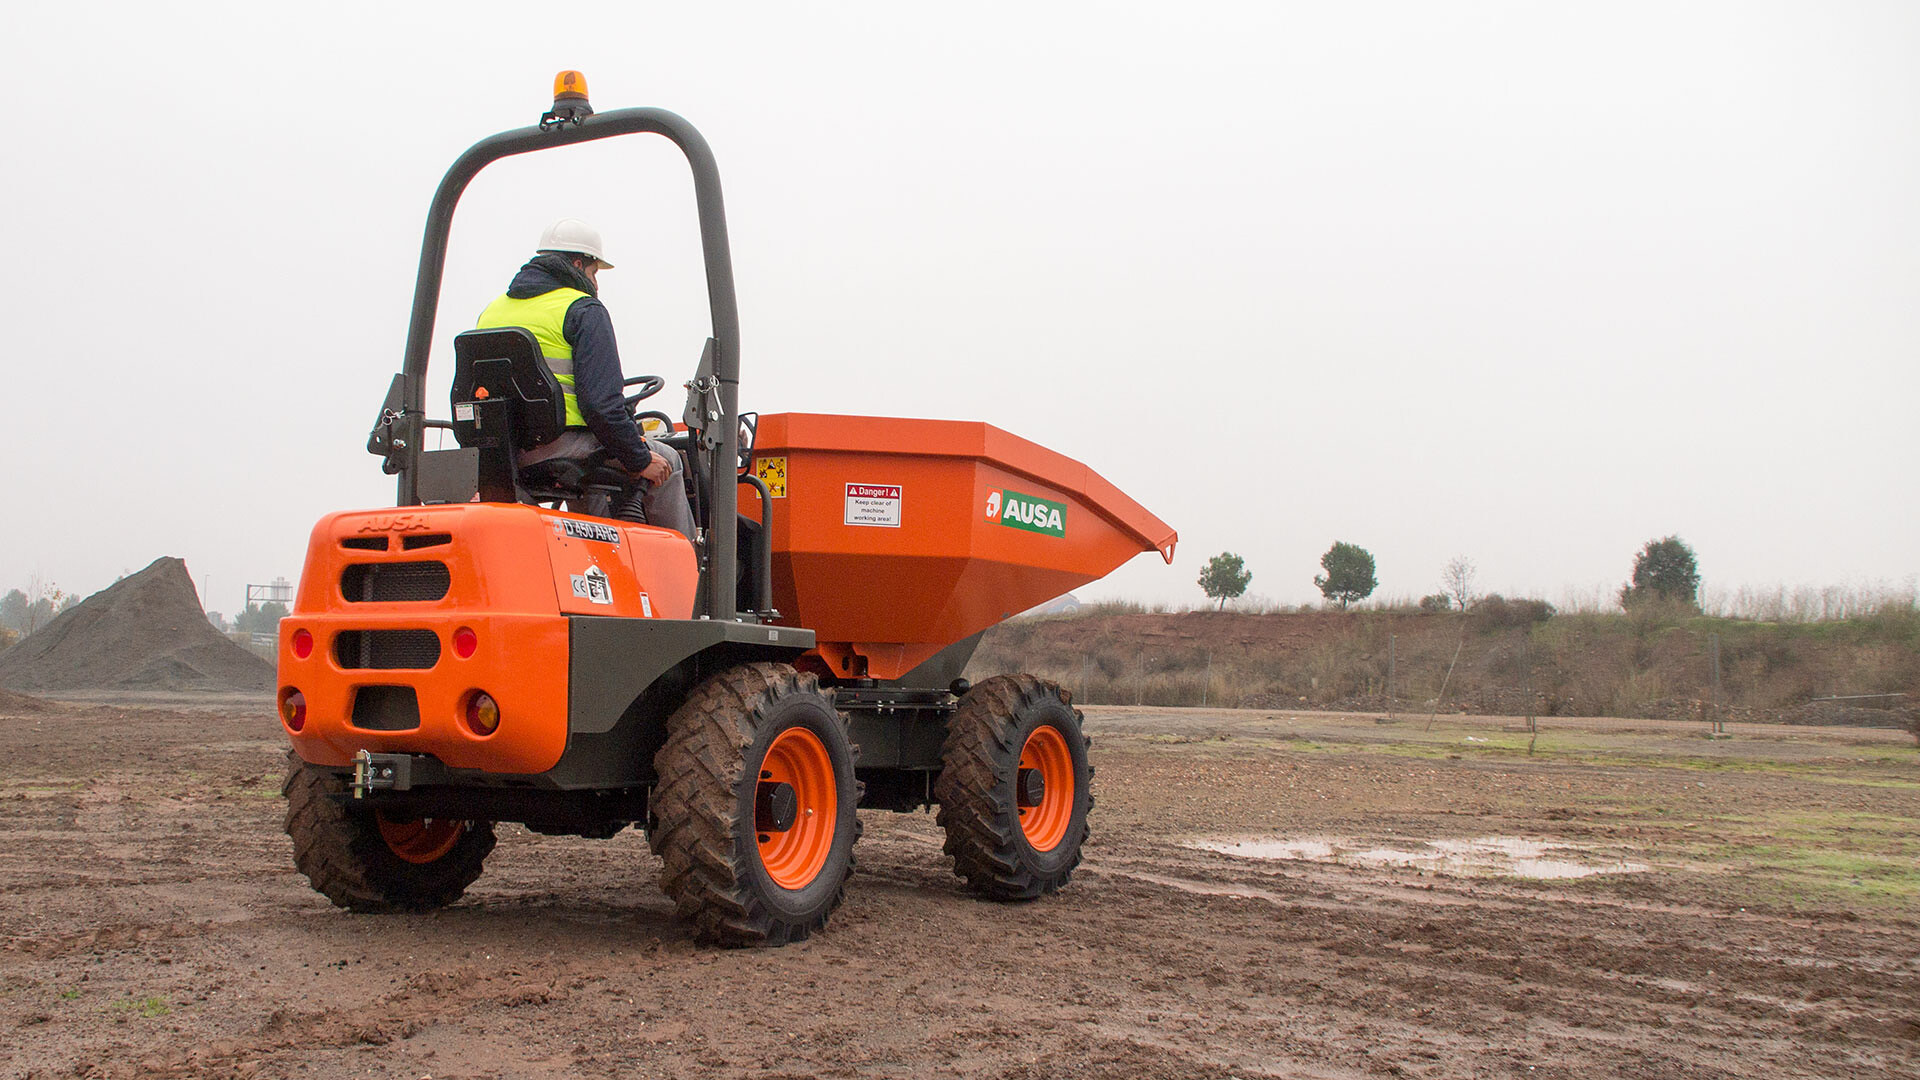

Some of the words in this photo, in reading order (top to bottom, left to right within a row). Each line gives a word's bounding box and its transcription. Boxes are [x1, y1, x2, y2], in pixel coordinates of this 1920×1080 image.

[357, 514, 430, 533] AUSA
[1003, 498, 1063, 531] AUSA
[563, 520, 573, 535] D
[575, 521, 594, 538] 450
[594, 524, 619, 542] AHG
